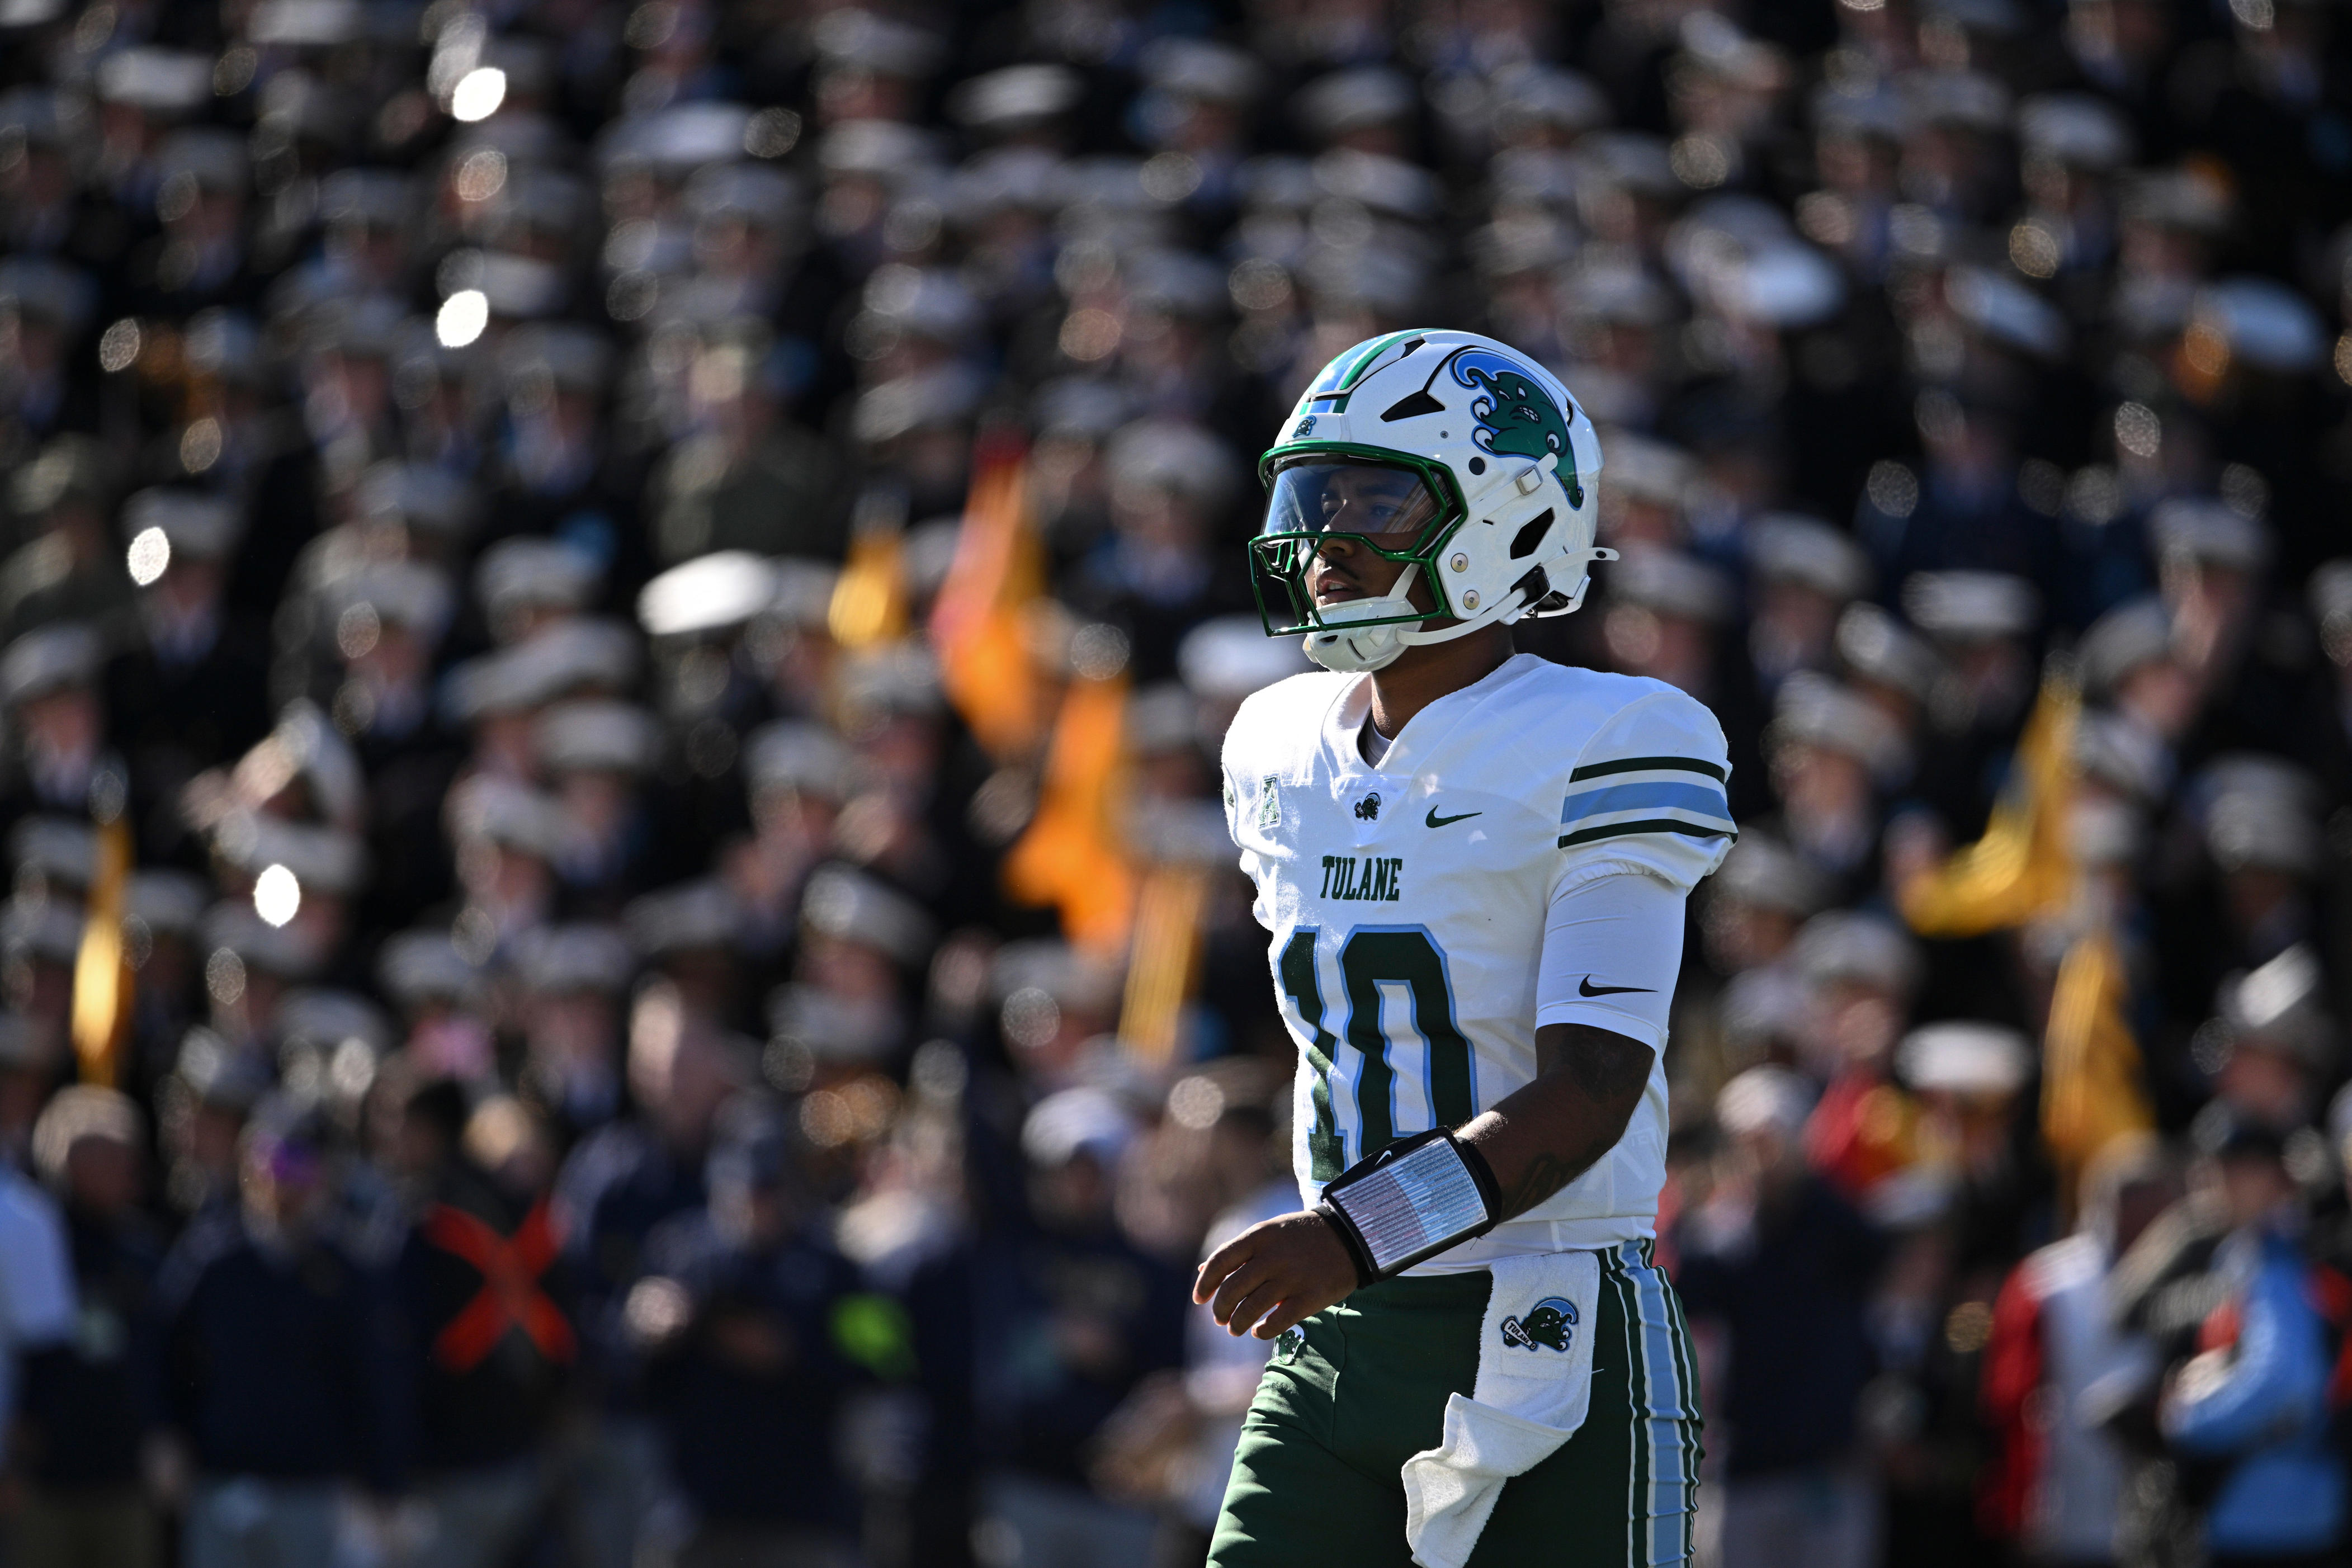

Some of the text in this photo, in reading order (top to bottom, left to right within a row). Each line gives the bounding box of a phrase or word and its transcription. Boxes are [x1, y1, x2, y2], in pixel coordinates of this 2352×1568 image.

[1320, 856, 1402, 901] TULANE
[1277, 924, 1480, 1188] 10
[1508, 1323, 1529, 1344] TULANE
